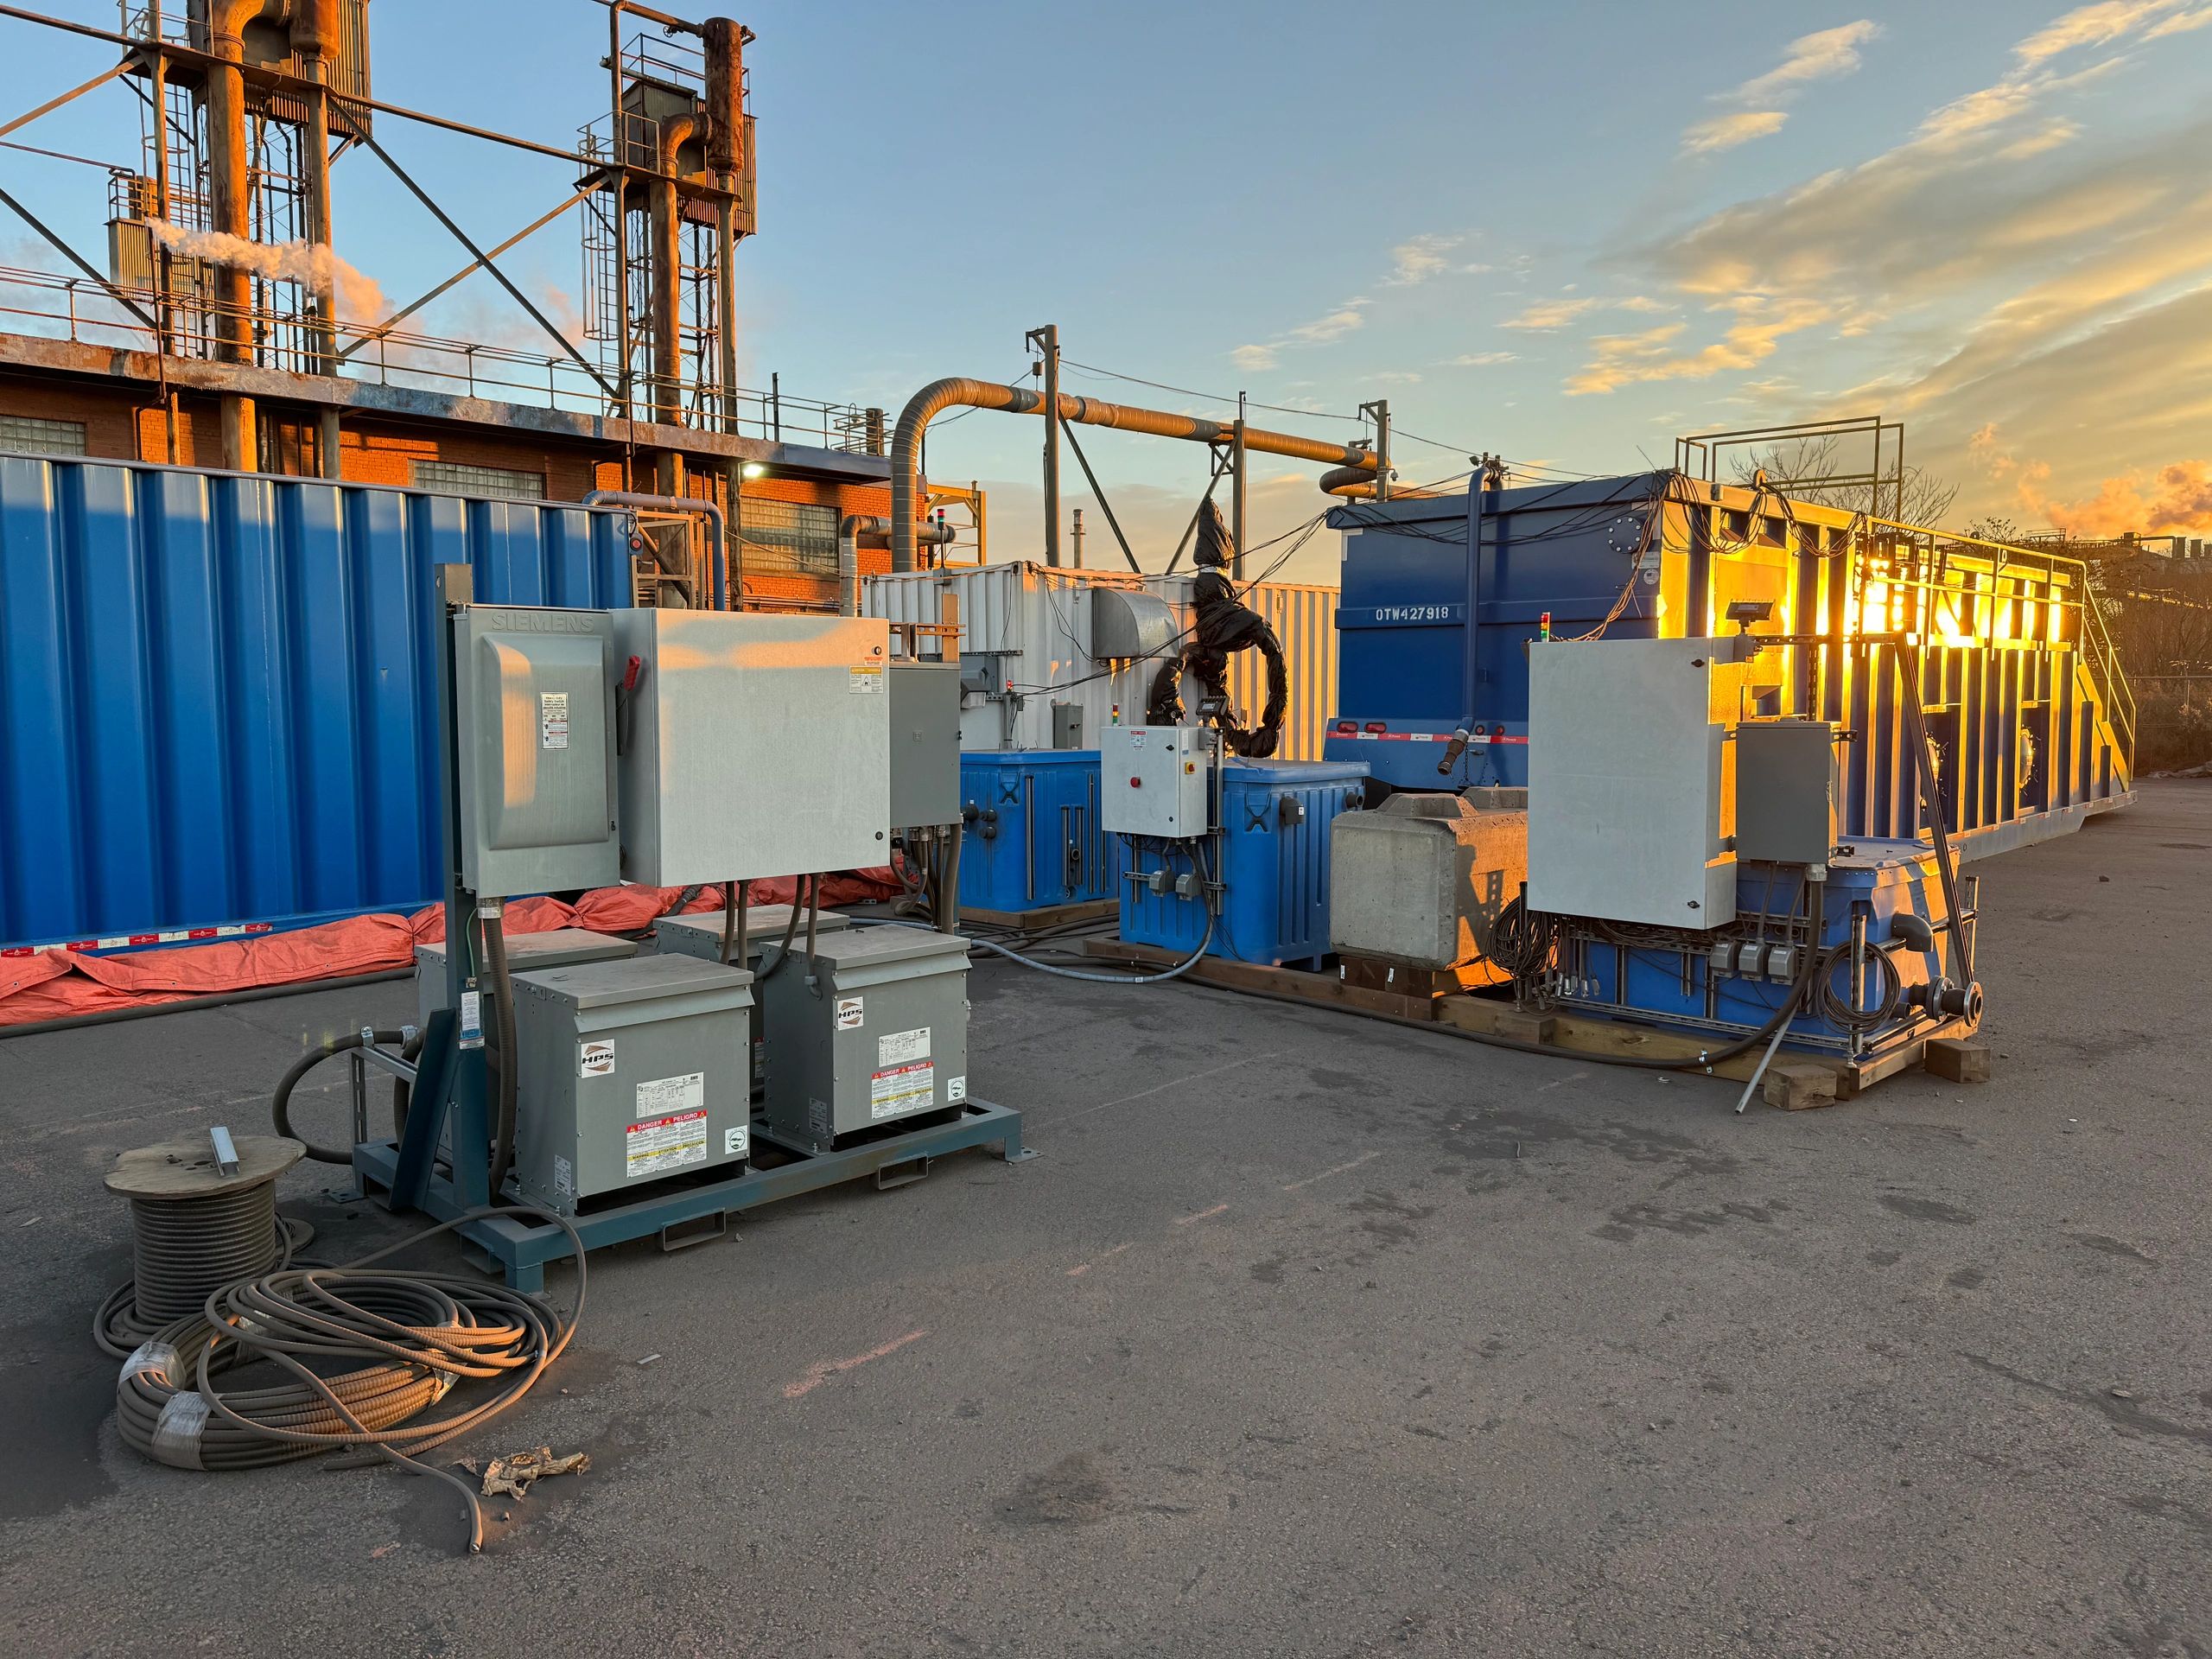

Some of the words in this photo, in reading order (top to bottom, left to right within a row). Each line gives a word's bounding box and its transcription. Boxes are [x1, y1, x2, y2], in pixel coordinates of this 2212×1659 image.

[491, 612, 594, 633] SIEMENS
[838, 1009, 862, 1019] HPS
[582, 1052, 614, 1064] HPS
[880, 1068, 899, 1077] DANGER
[907, 1063, 927, 1071] PELIGRO
[637, 1120, 663, 1130] DANGER
[673, 1112, 698, 1122] PELIGRO
